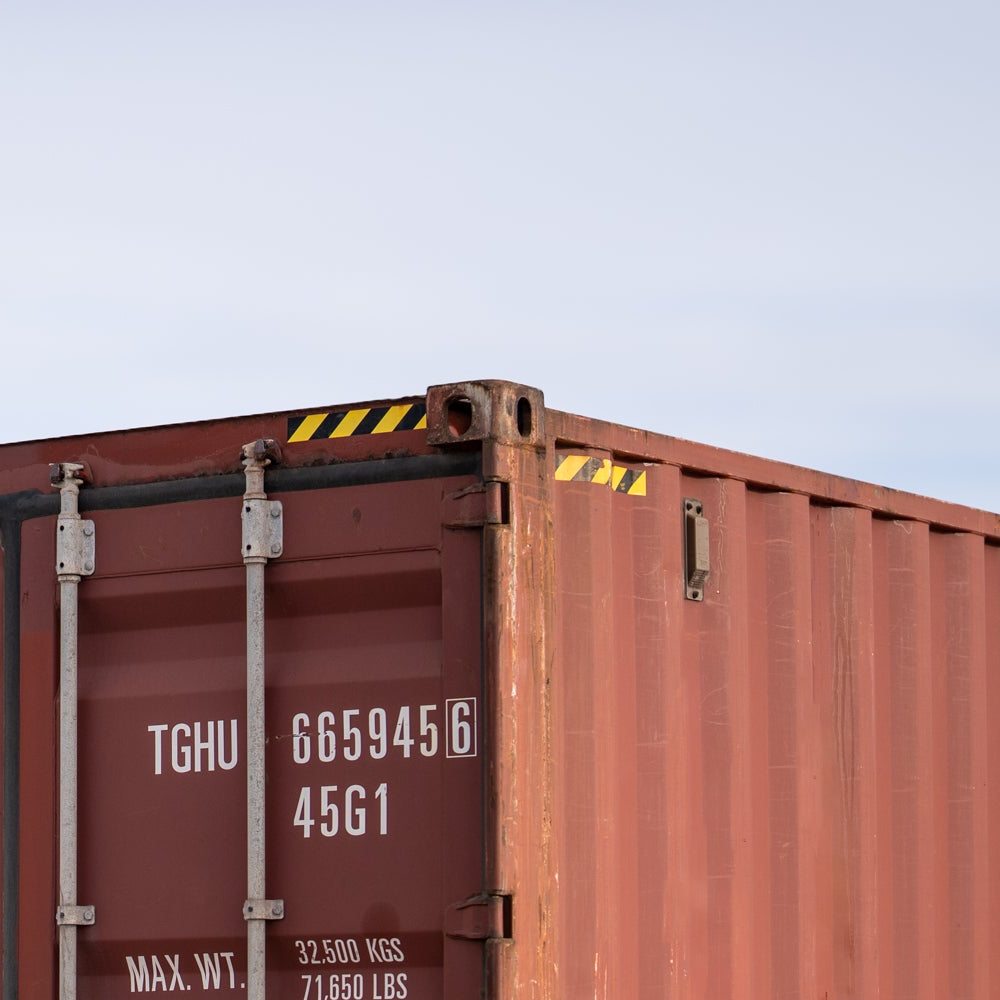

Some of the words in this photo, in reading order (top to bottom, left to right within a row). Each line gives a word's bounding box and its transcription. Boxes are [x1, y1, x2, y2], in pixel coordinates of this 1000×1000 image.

[147, 719, 238, 775] TGHU
[293, 782, 388, 838] 45G1
[295, 938, 361, 964] 32,500
[365, 938, 405, 963] KGS
[125, 954, 191, 992] MAX.
[194, 952, 246, 990] WT.
[301, 973, 364, 1000] 71,650
[372, 972, 408, 1000] LBS
